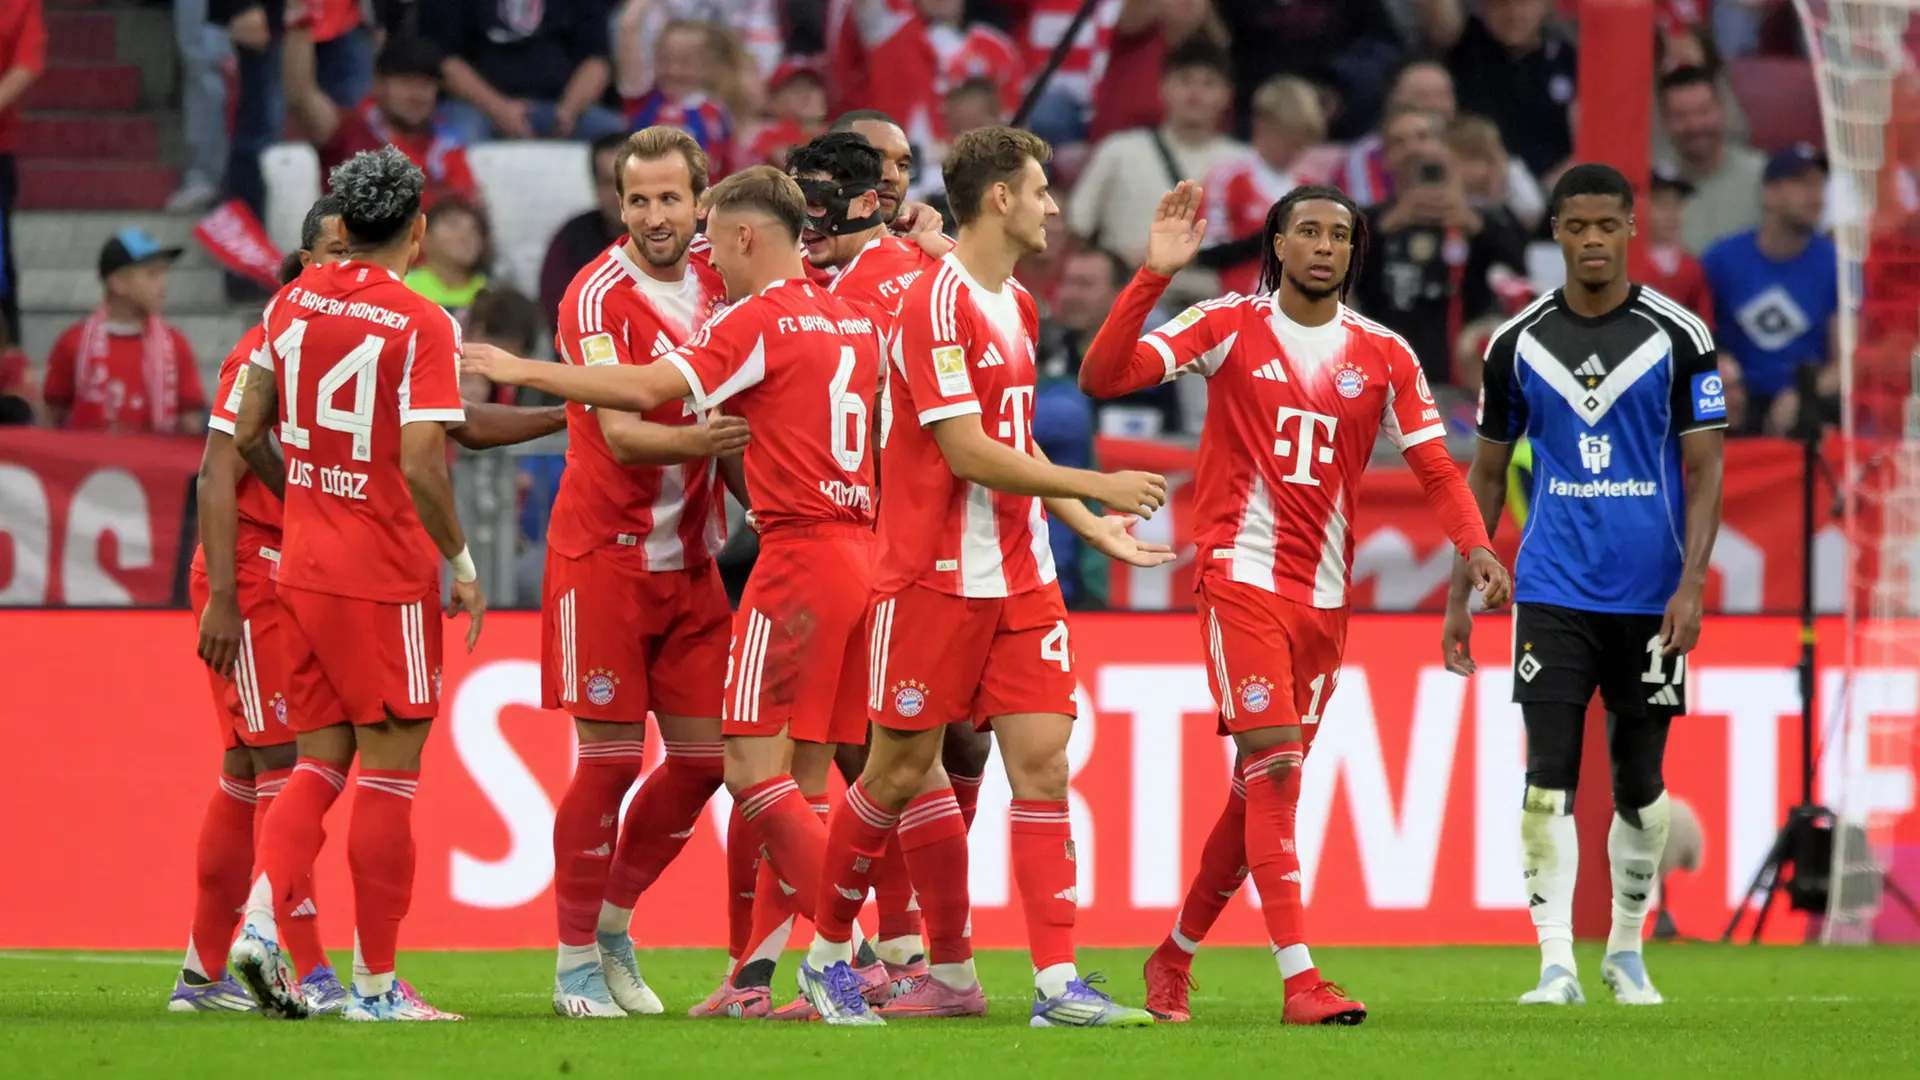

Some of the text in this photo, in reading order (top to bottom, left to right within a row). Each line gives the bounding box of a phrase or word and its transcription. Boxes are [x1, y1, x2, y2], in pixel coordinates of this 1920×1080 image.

[286, 287, 302, 303] F
[299, 290, 347, 316] BAYERN
[777, 317, 798, 335] FC
[273, 317, 385, 462] 14
[829, 346, 867, 472] 6
[1274, 406, 1338, 486] T
[320, 464, 368, 500] DÍAZ
[1549, 478, 1656, 497] aneMerku
[1523, 868, 1538, 879] SV
